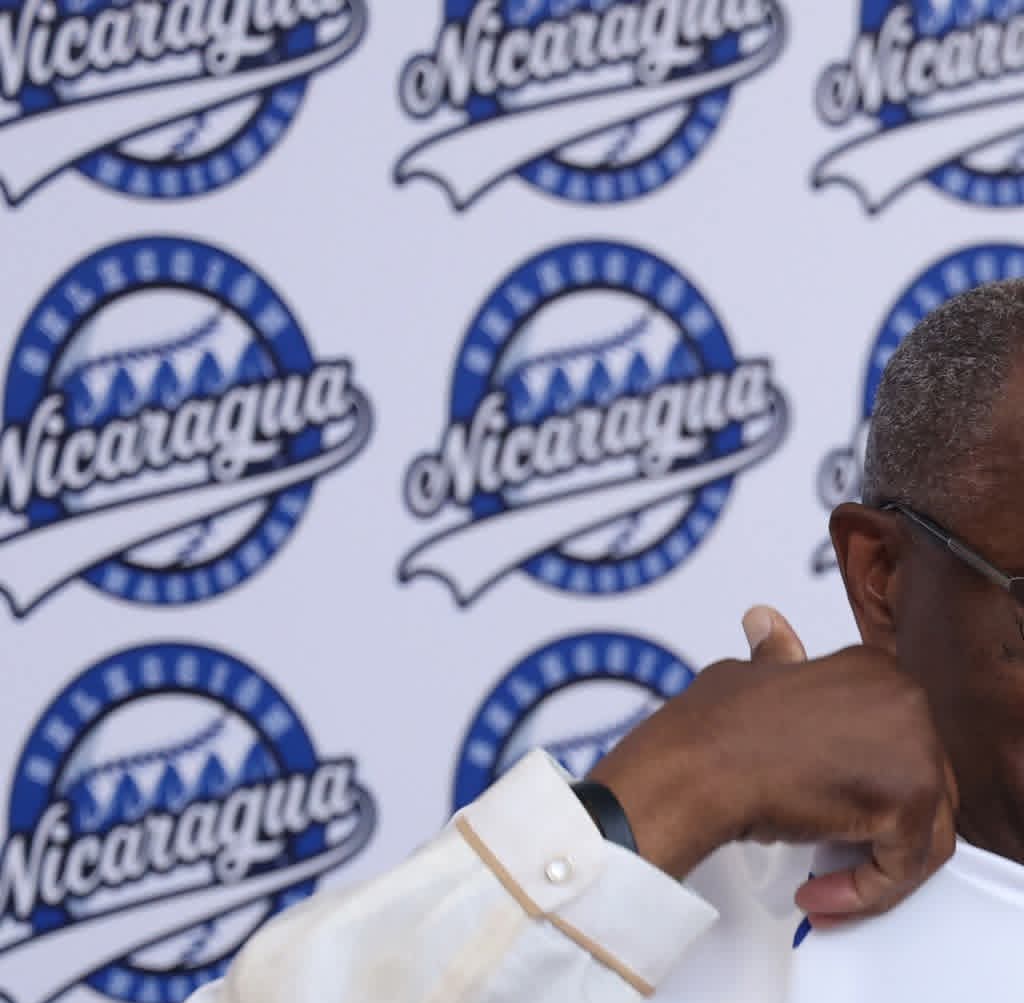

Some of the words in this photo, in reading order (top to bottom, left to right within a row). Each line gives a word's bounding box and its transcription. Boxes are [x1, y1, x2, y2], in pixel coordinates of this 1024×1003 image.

[0, 364, 351, 510] Nicaragua
[404, 362, 770, 517] Nicaragua
[0, 764, 355, 919] Nicaragua
